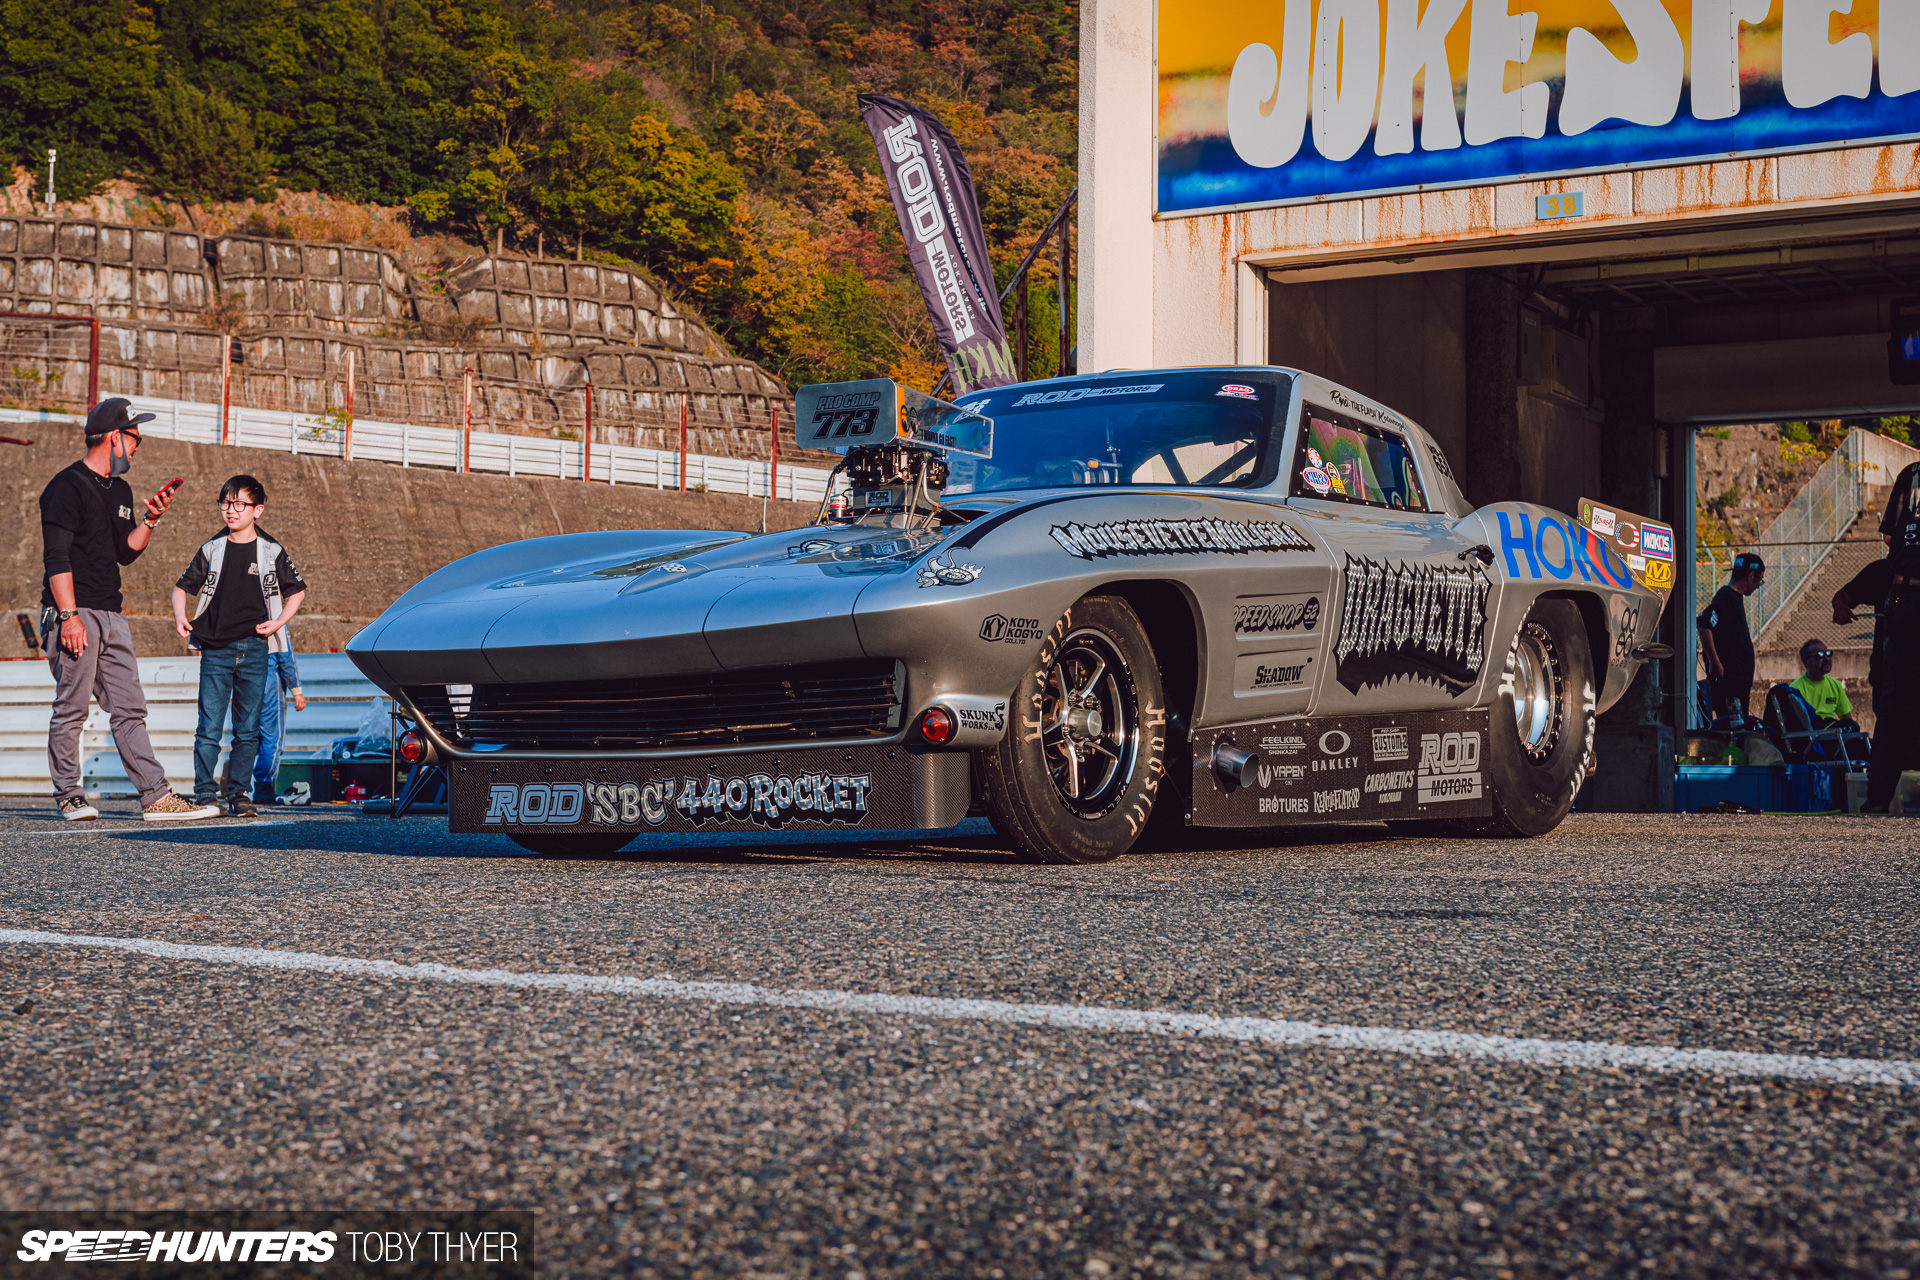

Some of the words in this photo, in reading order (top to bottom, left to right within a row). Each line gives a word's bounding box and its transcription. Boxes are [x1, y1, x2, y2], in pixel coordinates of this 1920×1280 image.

[1547, 195, 1576, 216] 38
[816, 394, 844, 410] PRO
[843, 392, 881, 408] COMP
[1012, 387, 1093, 408] ROD
[1099, 385, 1151, 396] MOTORS
[812, 406, 880, 440] 773
[1009, 617, 1039, 629] KOYO
[1006, 628, 1043, 639] KOGYO
[1255, 665, 1304, 685] SHADOW
[961, 720, 988, 730] WORKS
[1418, 731, 1481, 775] ROD
[1312, 757, 1358, 771] OAKLEY
[1364, 770, 1414, 793] CARBONETICS
[1431, 777, 1473, 797] MOTORS
[485, 782, 583, 825] ROD
[676, 776, 748, 824] 440
[748, 773, 871, 826] ROCKET
